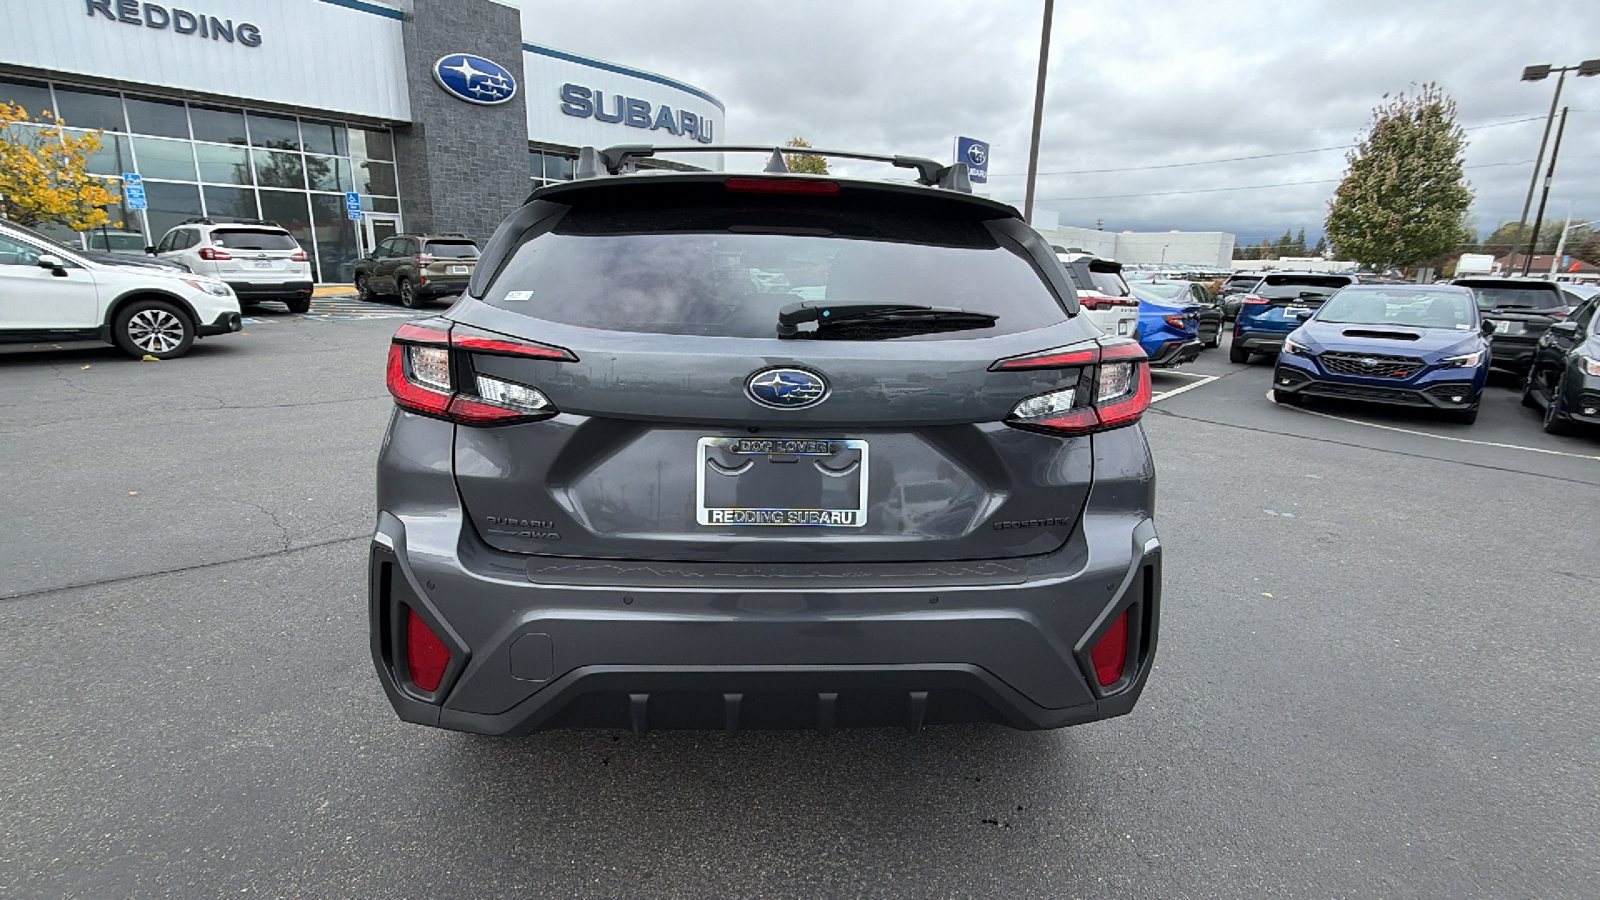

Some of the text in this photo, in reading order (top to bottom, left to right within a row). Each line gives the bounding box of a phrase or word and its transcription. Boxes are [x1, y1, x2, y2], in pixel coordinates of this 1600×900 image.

[86, 0, 262, 47] REDDING
[561, 82, 714, 144] SUBARU
[968, 167, 987, 178] UBARU
[741, 440, 828, 453] DOG LOVER
[486, 516, 555, 529] SUBARU
[712, 510, 853, 524] REDDING SUBARU
[993, 516, 1070, 530] CROSSTREK
